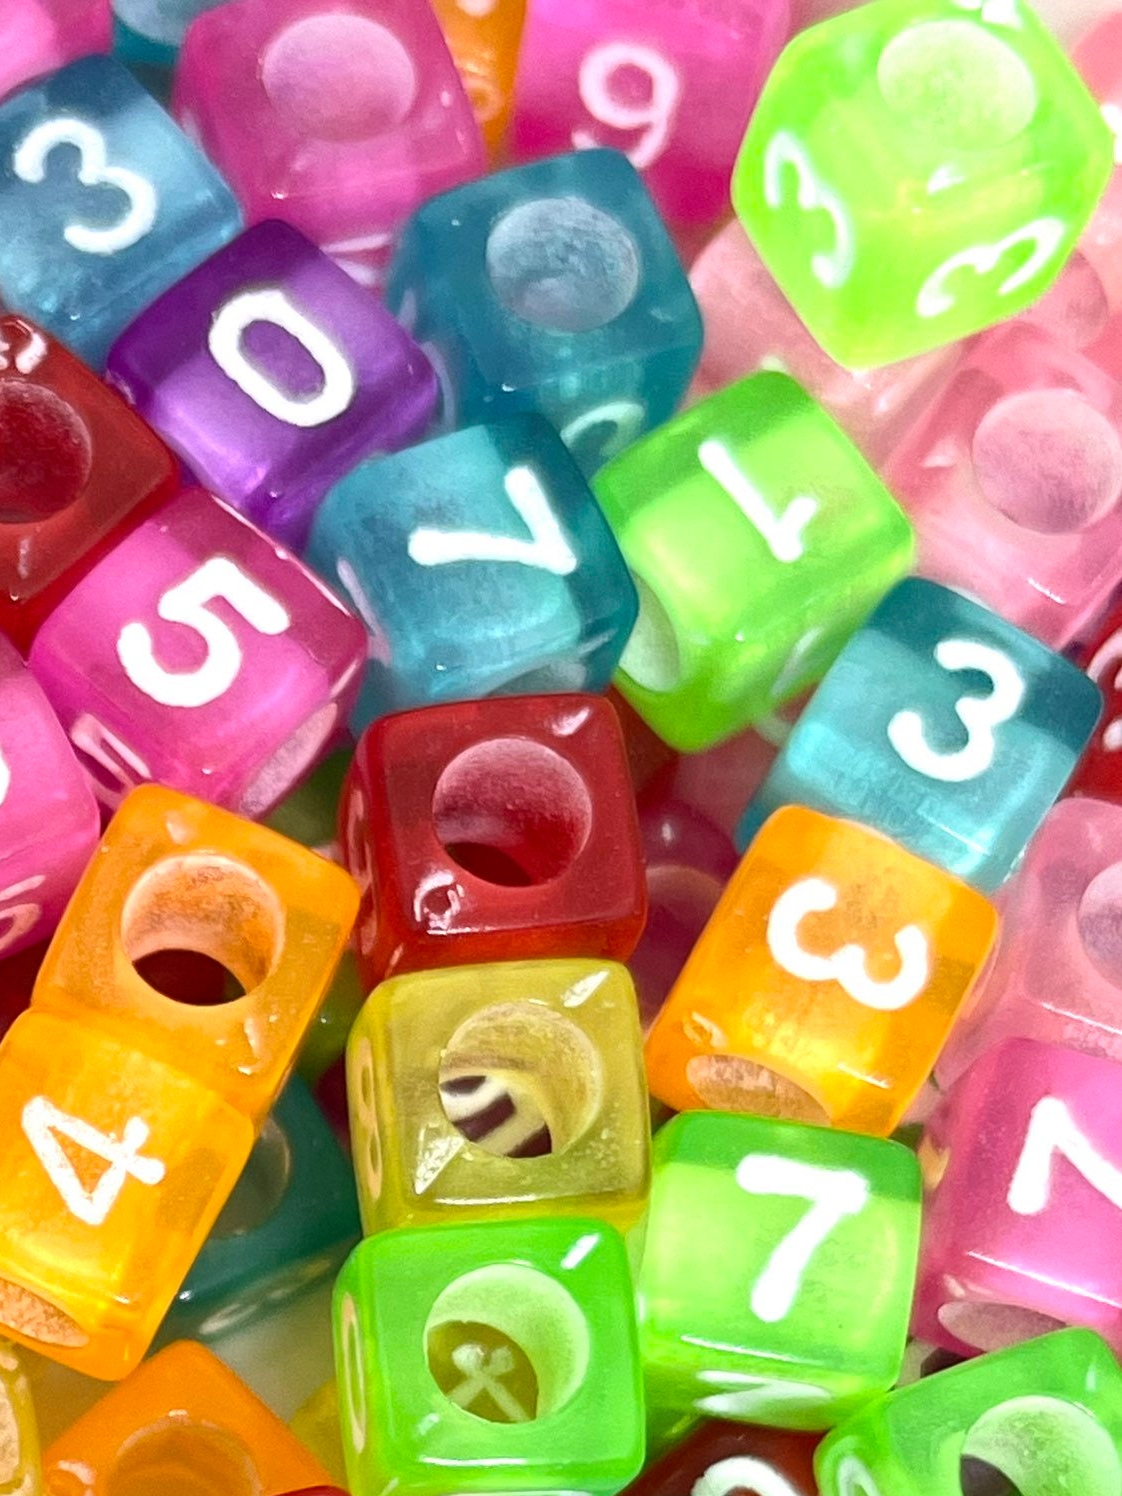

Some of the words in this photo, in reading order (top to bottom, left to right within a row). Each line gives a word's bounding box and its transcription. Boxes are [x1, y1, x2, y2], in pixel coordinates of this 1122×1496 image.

[572, 41, 678, 168] 9
[13, 118, 157, 254] 3
[765, 131, 853, 287] 3
[916, 218, 1065, 317] 3
[208, 288, 354, 427] 0
[408, 465, 577, 575] 7
[698, 437, 818, 562] 1
[116, 556, 290, 708] 5
[888, 638, 1026, 782] 3
[767, 879, 929, 1011] 3
[21, 1095, 166, 1226] 4
[736, 1154, 869, 1322] 7
